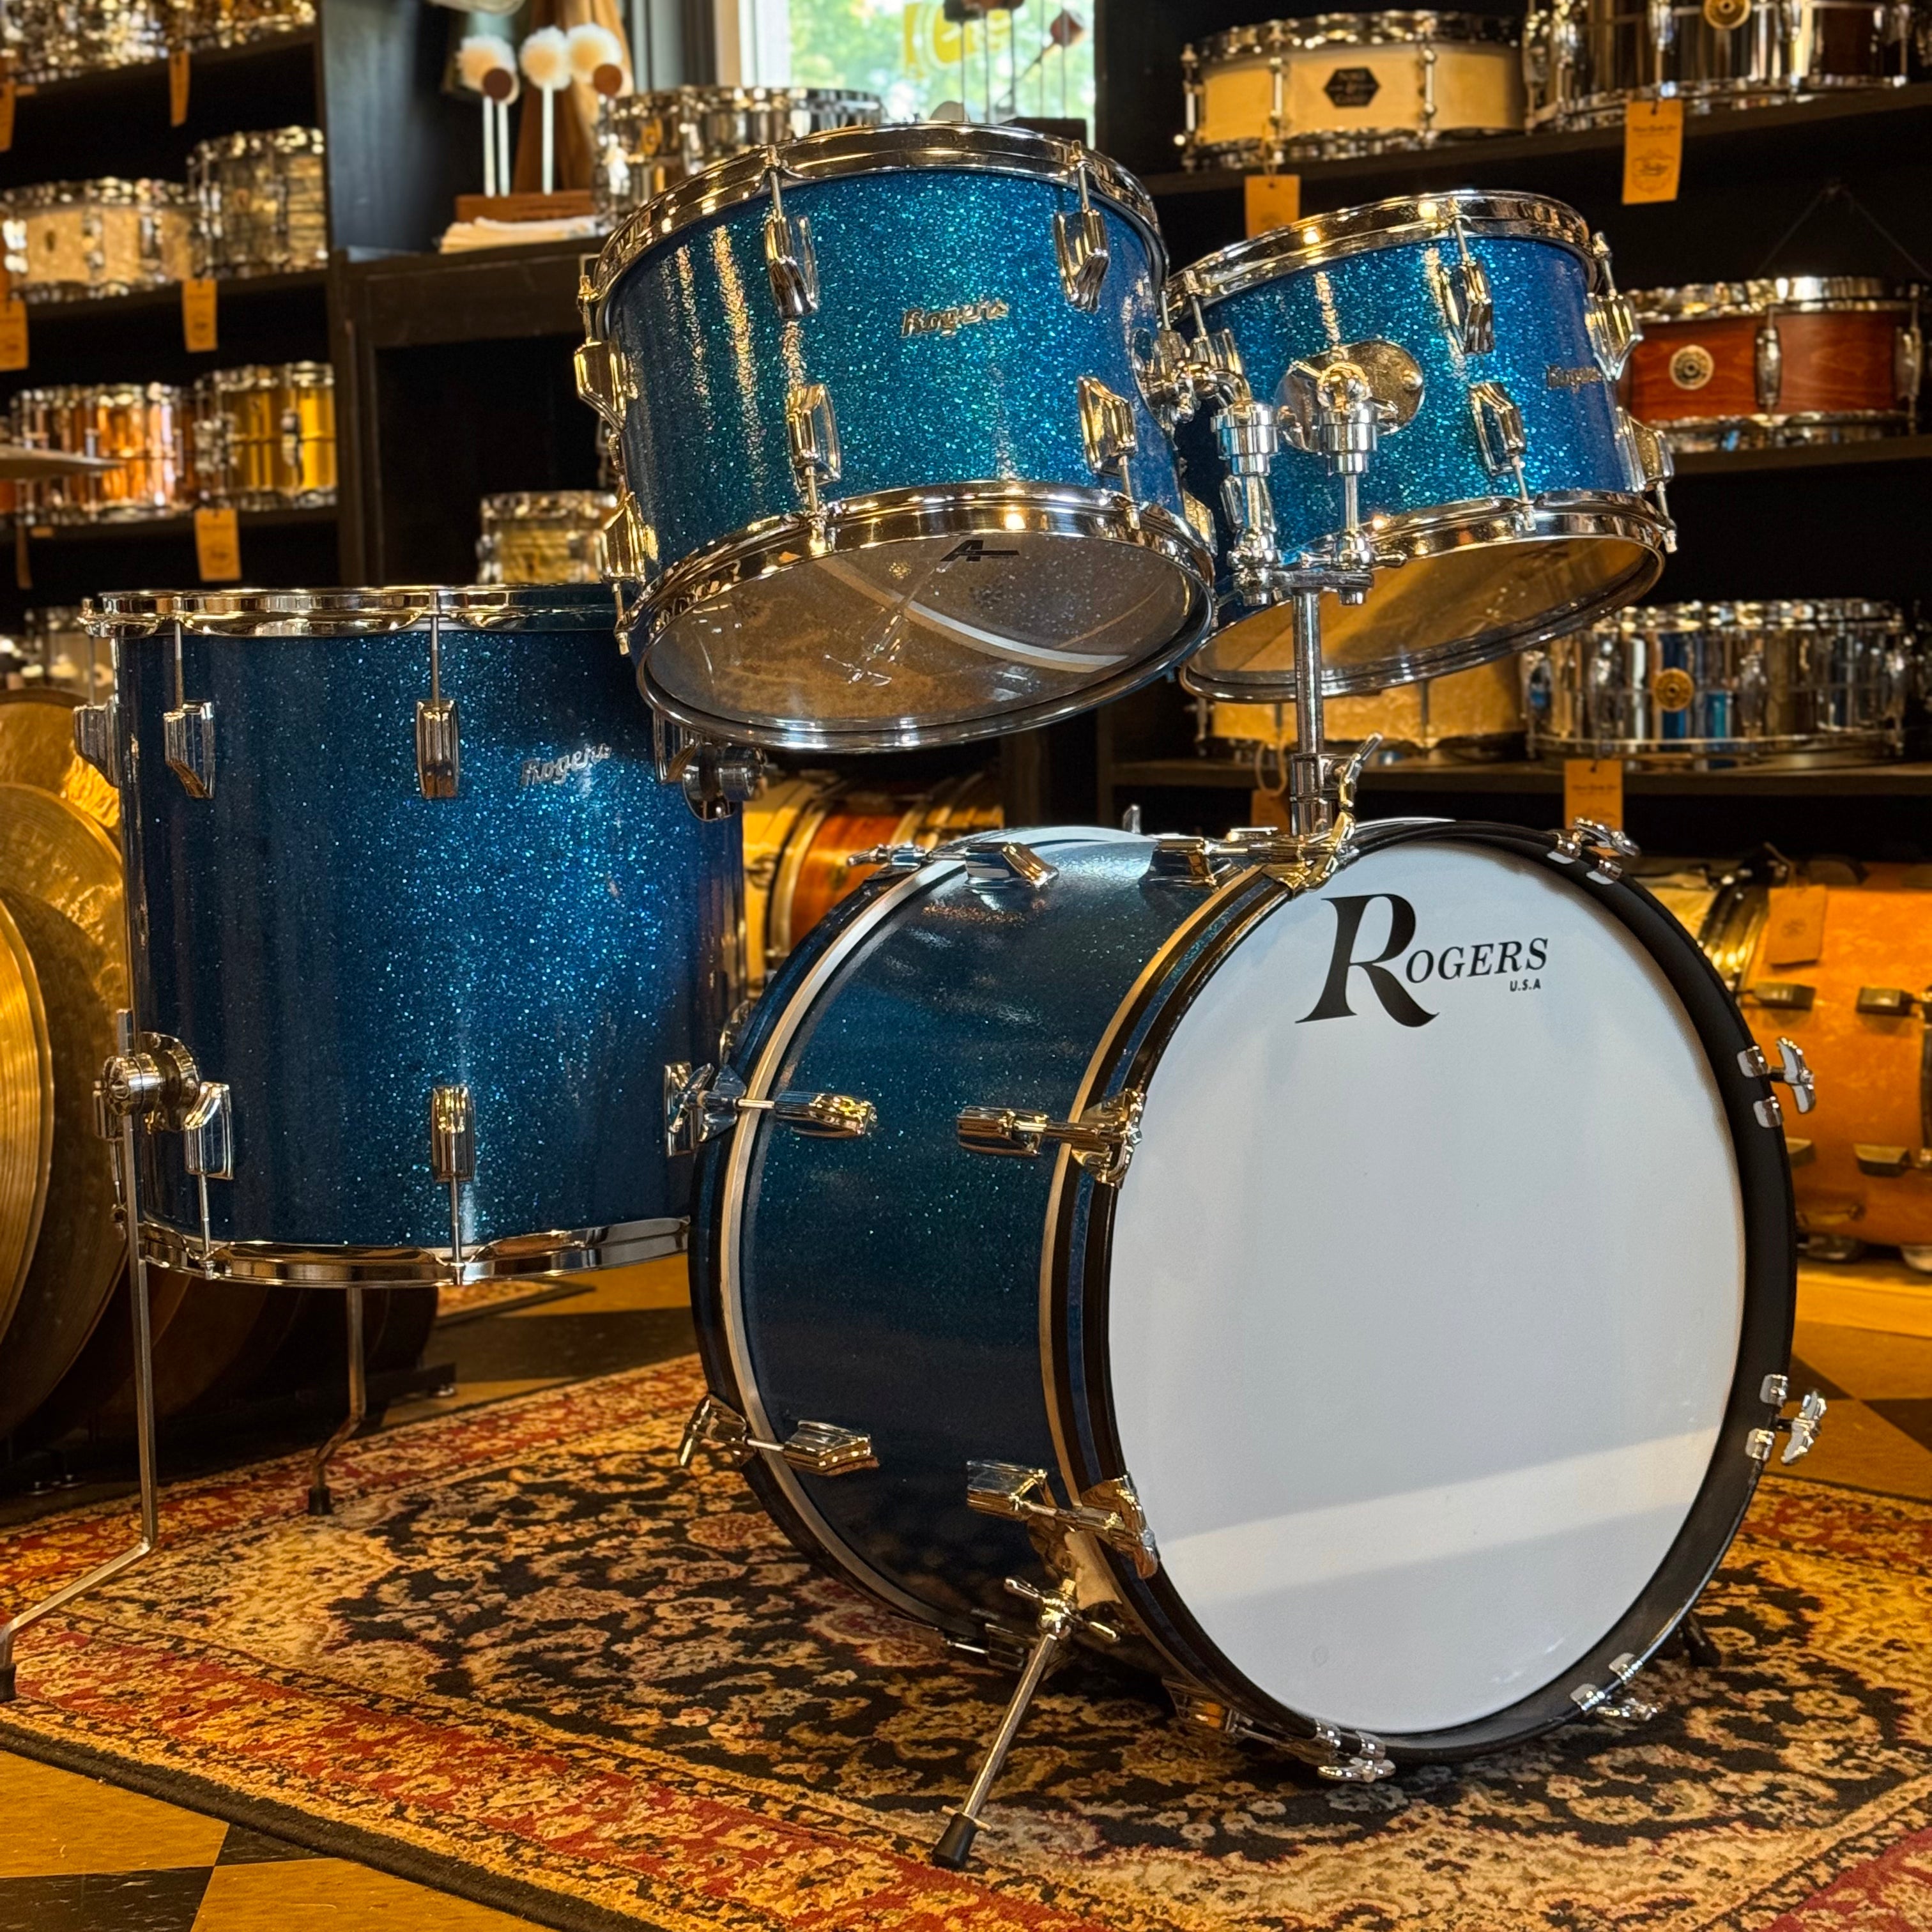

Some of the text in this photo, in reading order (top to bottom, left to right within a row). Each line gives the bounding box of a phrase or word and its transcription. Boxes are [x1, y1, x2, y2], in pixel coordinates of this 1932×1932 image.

[900, 298, 1009, 338] Rogers
[521, 742, 611, 786] Rogers
[1509, 978, 1542, 992] U.S.A
